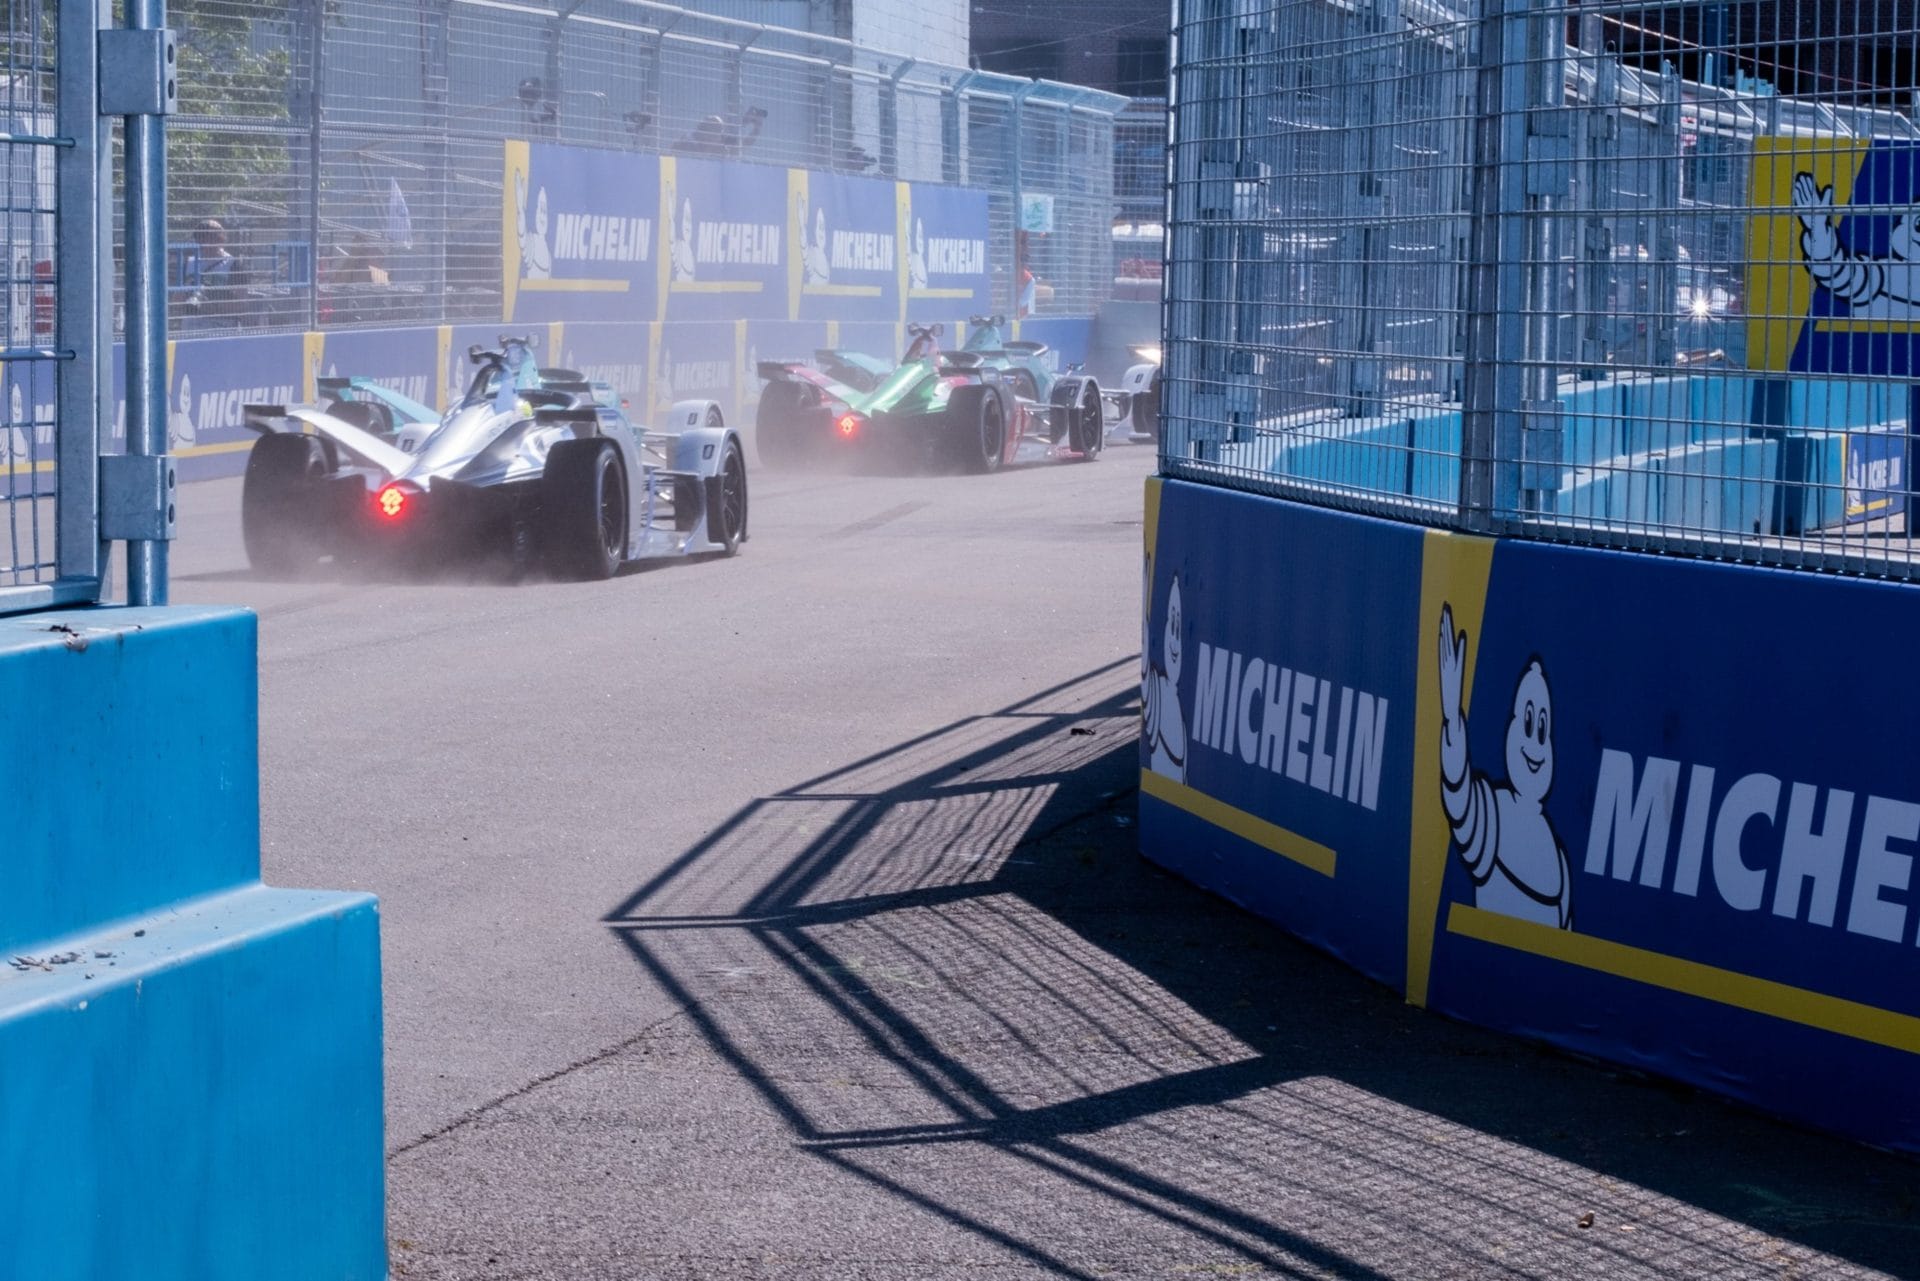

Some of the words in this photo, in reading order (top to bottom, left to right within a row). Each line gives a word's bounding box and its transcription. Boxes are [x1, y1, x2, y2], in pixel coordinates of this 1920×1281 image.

[554, 213, 650, 261] MICHELIN
[697, 221, 780, 265] MICHELIN
[832, 230, 893, 271] MICHELIN
[928, 238, 984, 274] MICHELIN
[1192, 641, 1389, 812] MICHELIN
[1585, 748, 1920, 948] MICHE
